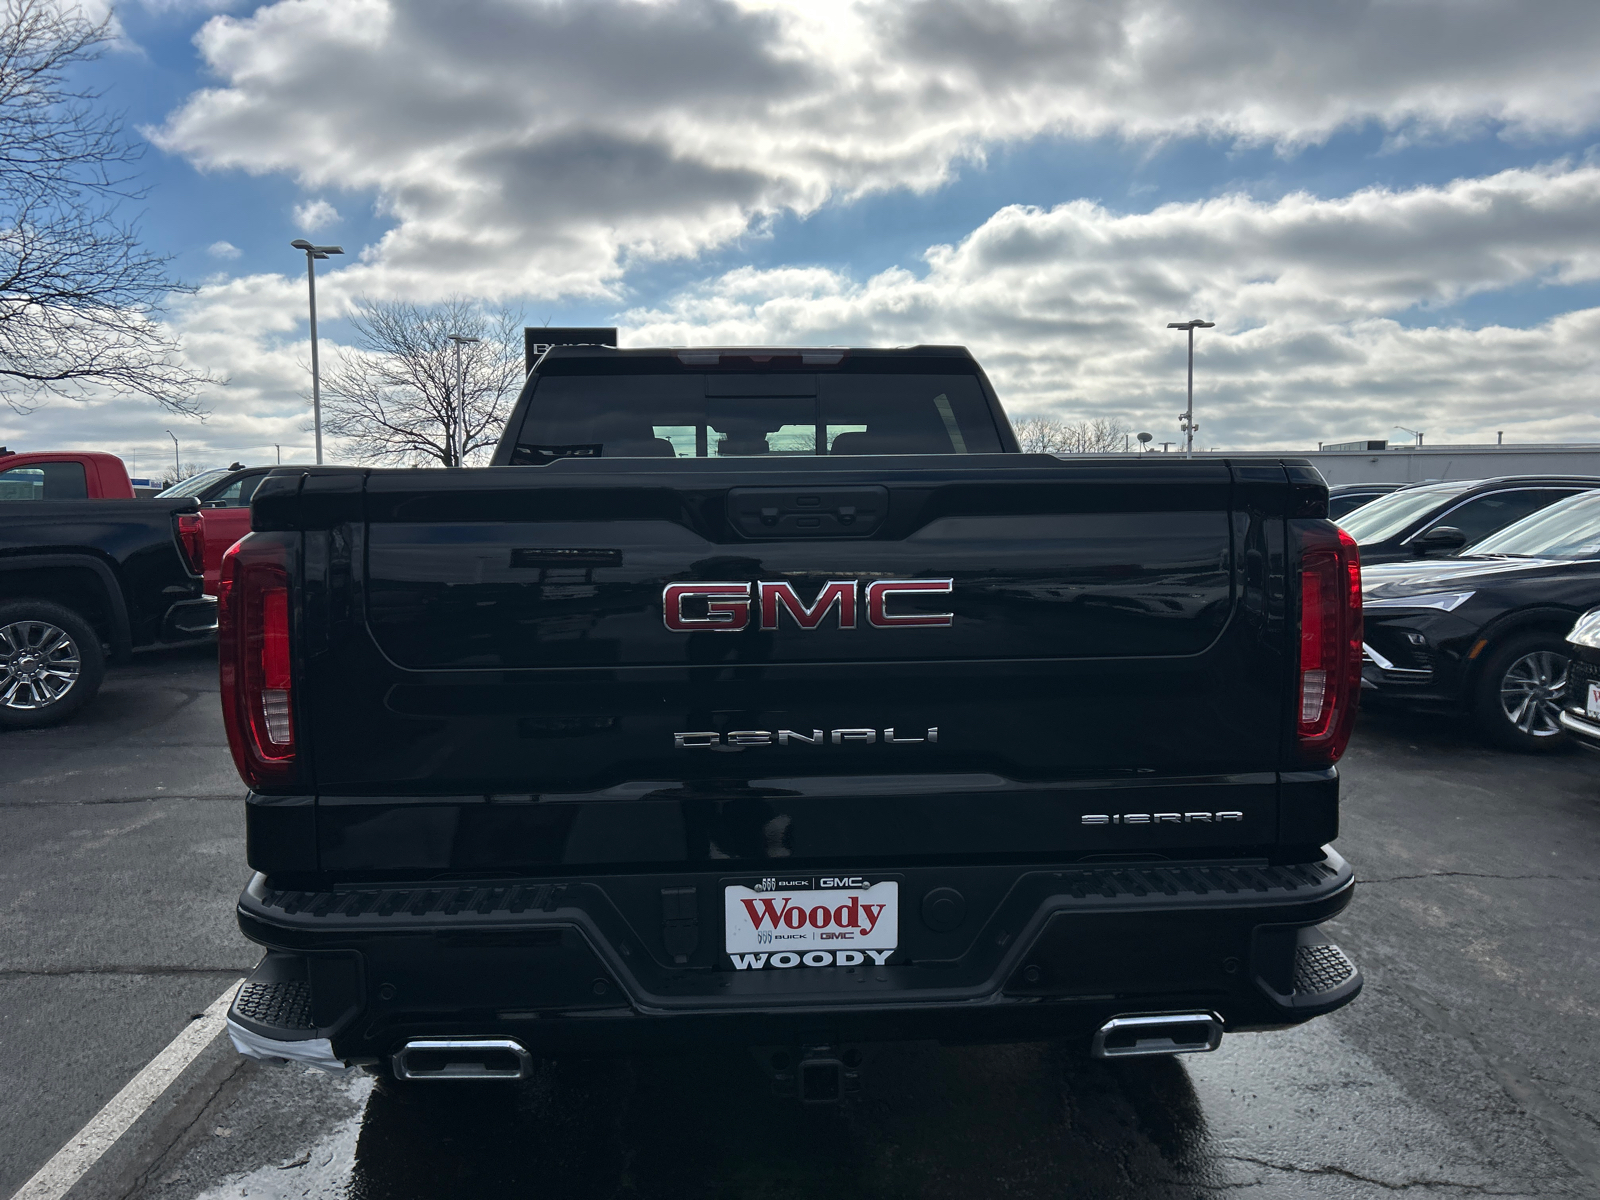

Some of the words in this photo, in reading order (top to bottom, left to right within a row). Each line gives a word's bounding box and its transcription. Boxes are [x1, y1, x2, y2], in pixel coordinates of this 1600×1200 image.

[662, 578, 954, 632] GMC
[674, 727, 938, 748] DENALI
[1081, 811, 1243, 824] SIERRA
[820, 877, 863, 888] GMC
[740, 896, 886, 936] Woody
[820, 932, 854, 940] GMC
[729, 950, 895, 970] WOODY
